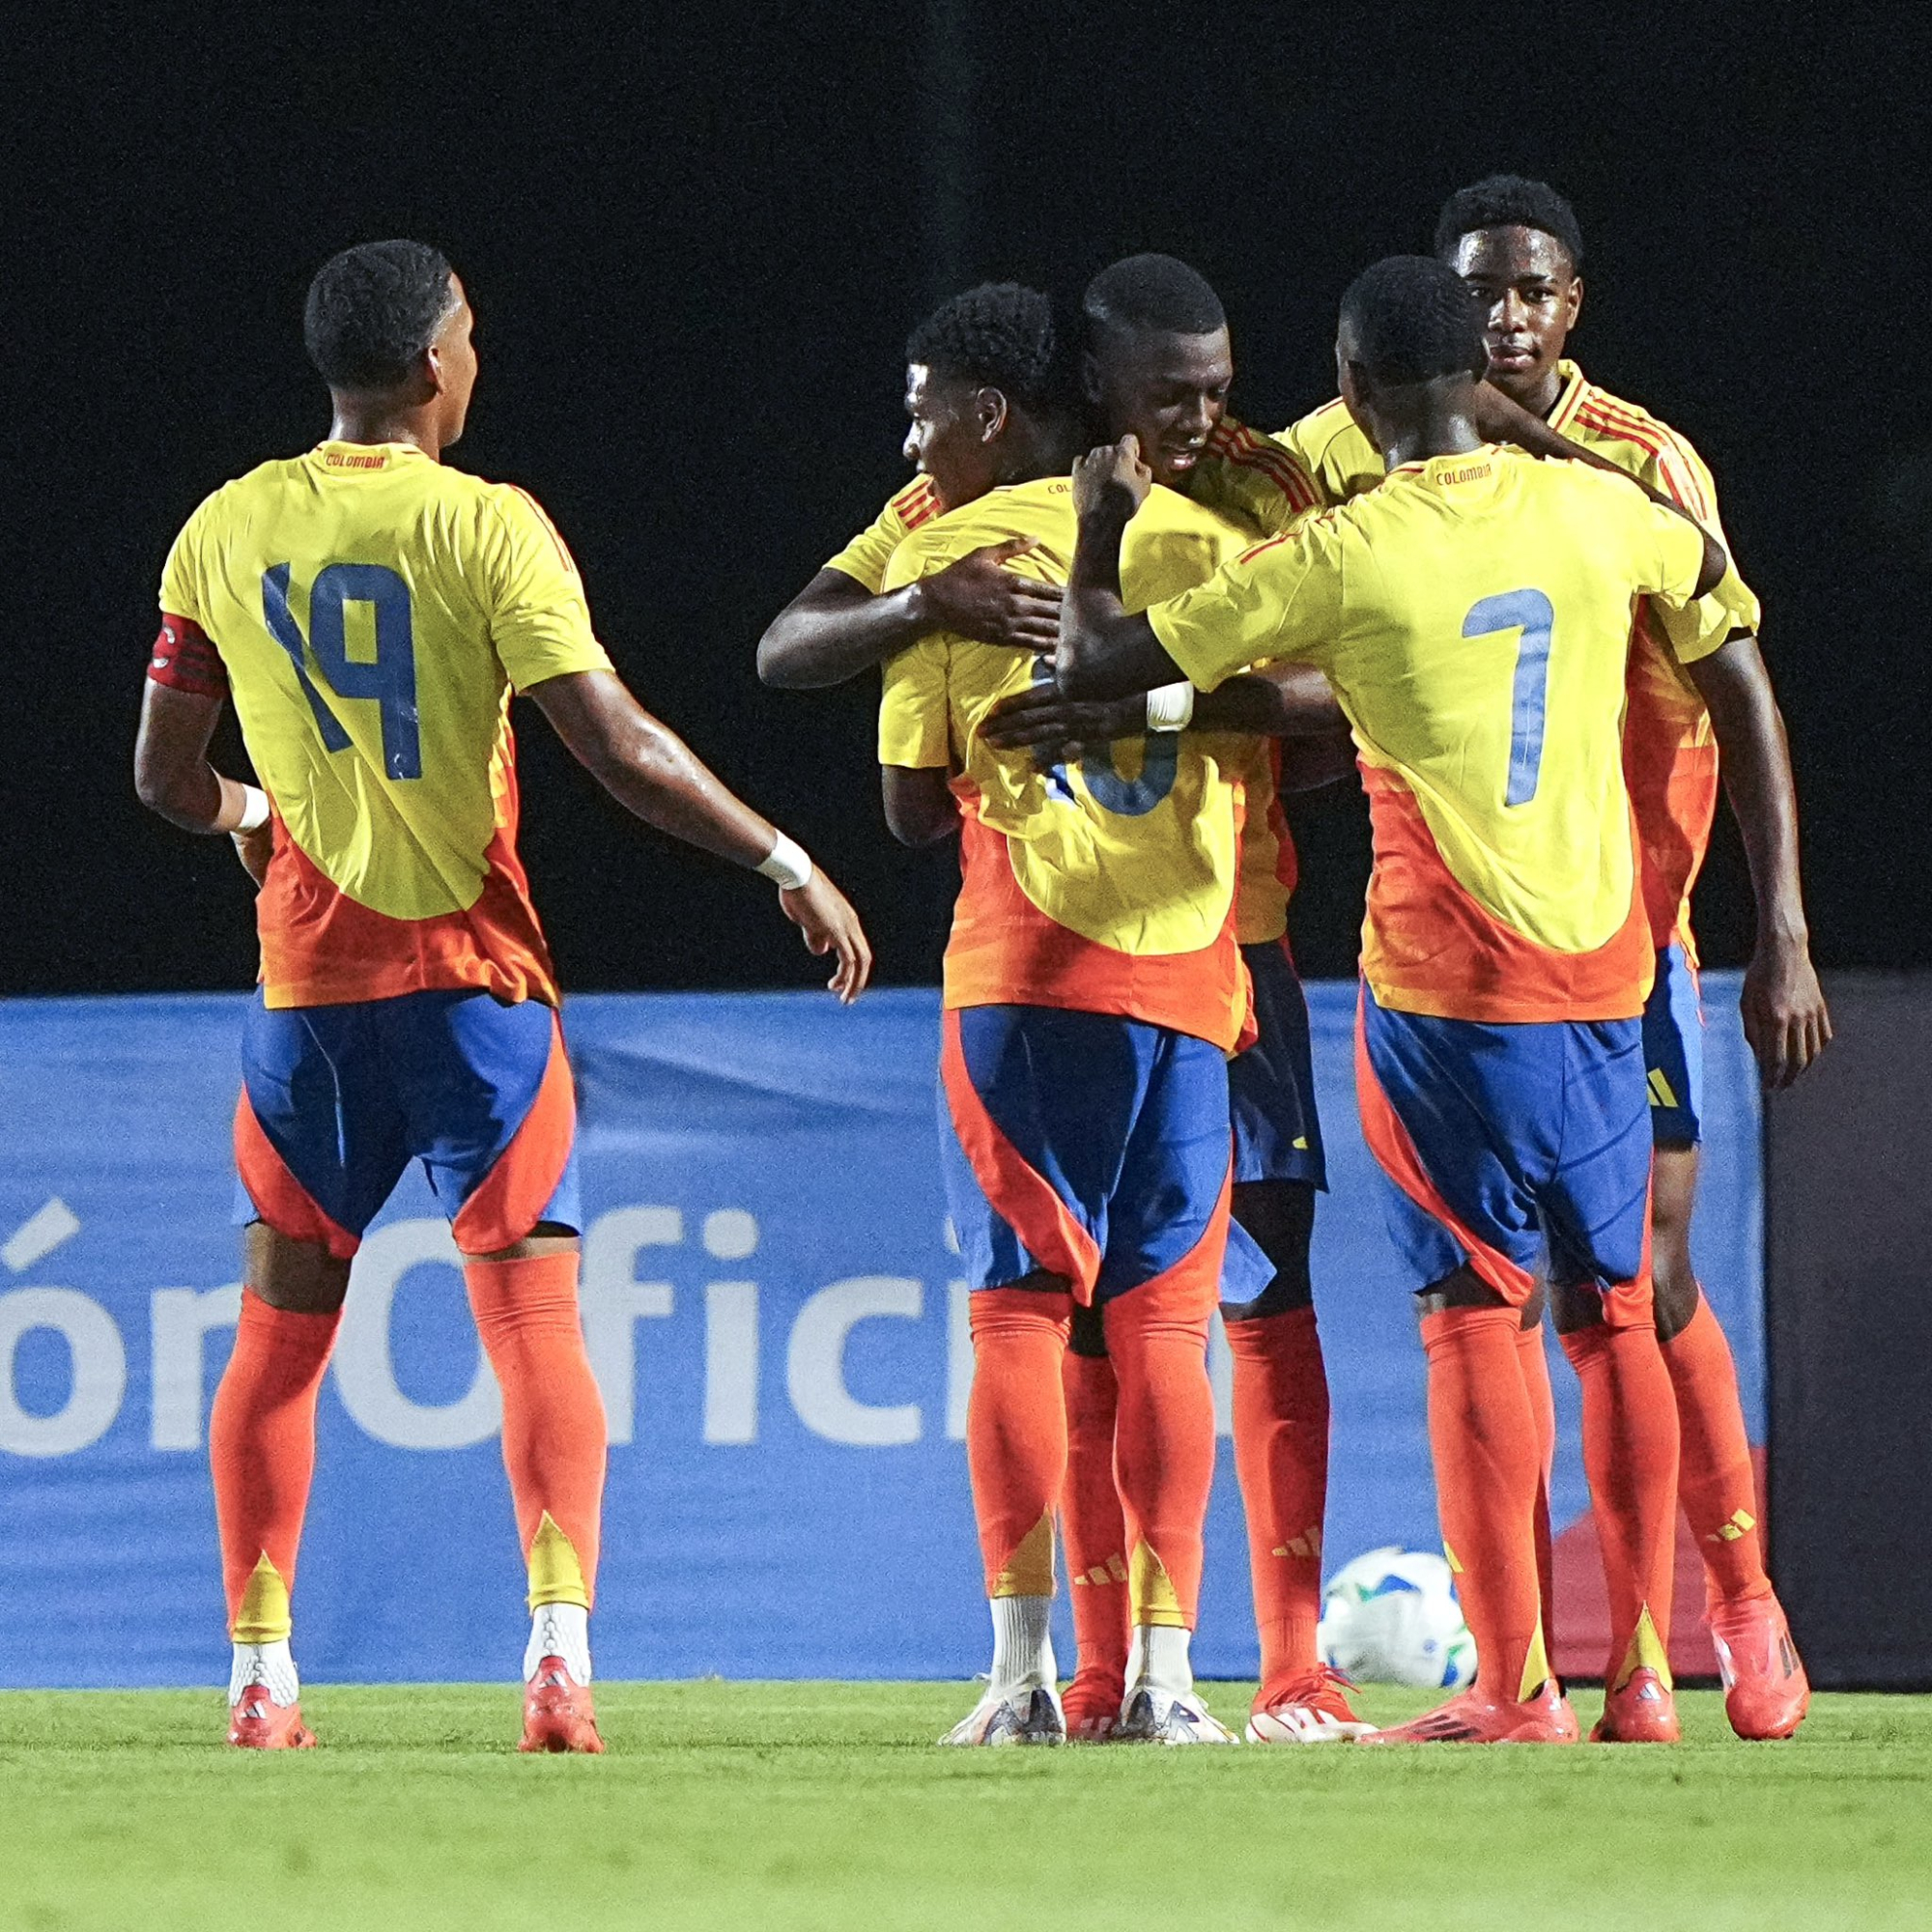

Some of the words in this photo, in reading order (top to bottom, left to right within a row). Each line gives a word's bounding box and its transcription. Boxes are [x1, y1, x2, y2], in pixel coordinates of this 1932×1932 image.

[326, 452, 385, 469] COLOMBIA
[1435, 463, 1492, 486] COLOMBIA
[261, 561, 422, 781] 19
[1462, 587, 1554, 807] 7
